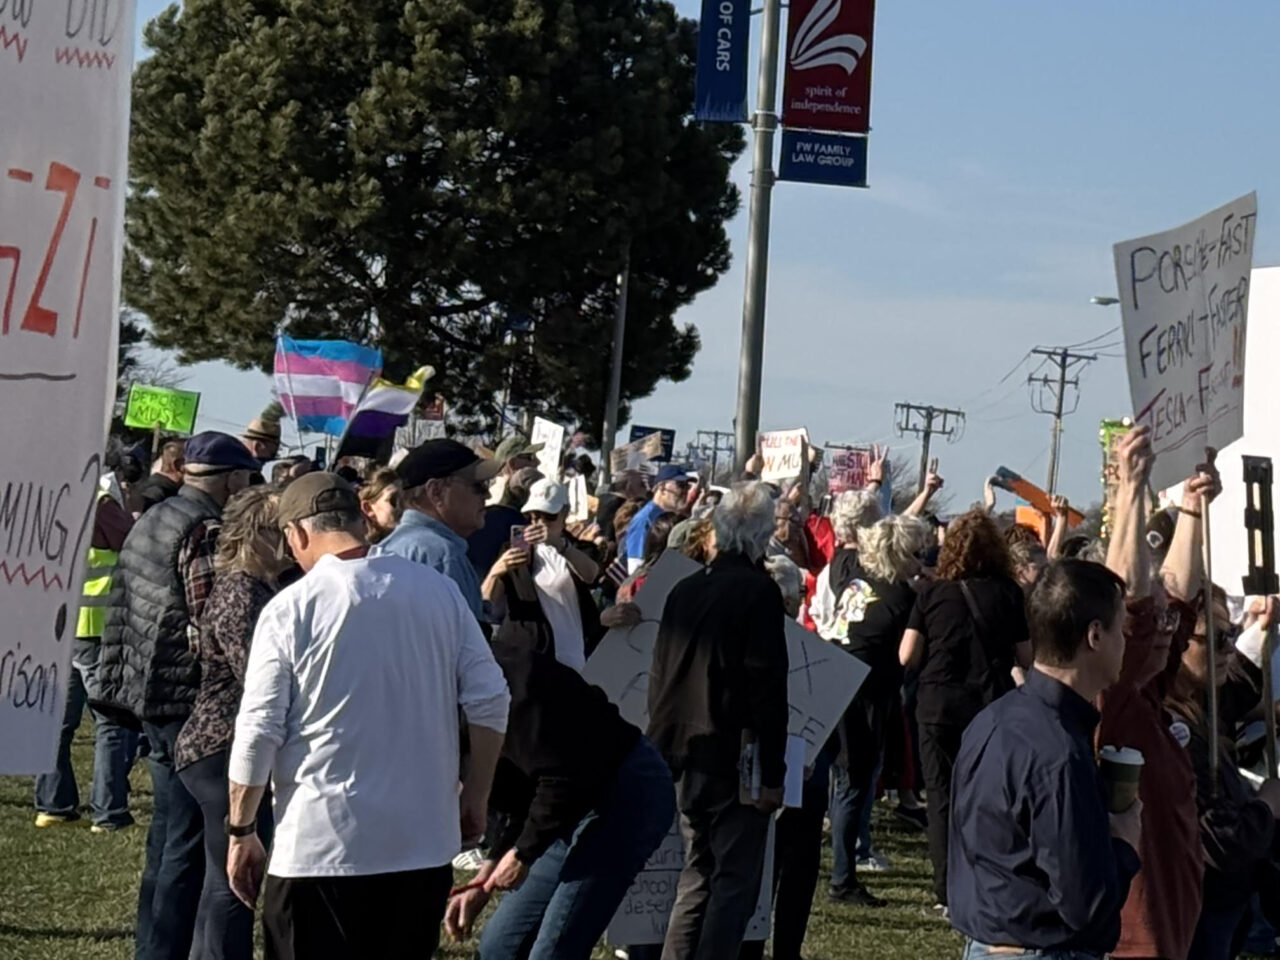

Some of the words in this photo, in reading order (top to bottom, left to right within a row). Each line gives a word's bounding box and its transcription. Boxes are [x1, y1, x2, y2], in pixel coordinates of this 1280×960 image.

[718, 2, 734, 24] OF
[715, 27, 732, 72] CARS
[805, 86, 833, 98] spirit
[835, 87, 849, 98] of
[791, 98, 862, 114] independence
[814, 142, 852, 156] FAMILY
[791, 152, 815, 164] LAW
[817, 155, 855, 168] GROUP
[131, 390, 193, 407] DEPORT
[134, 405, 184, 426] MUSK
